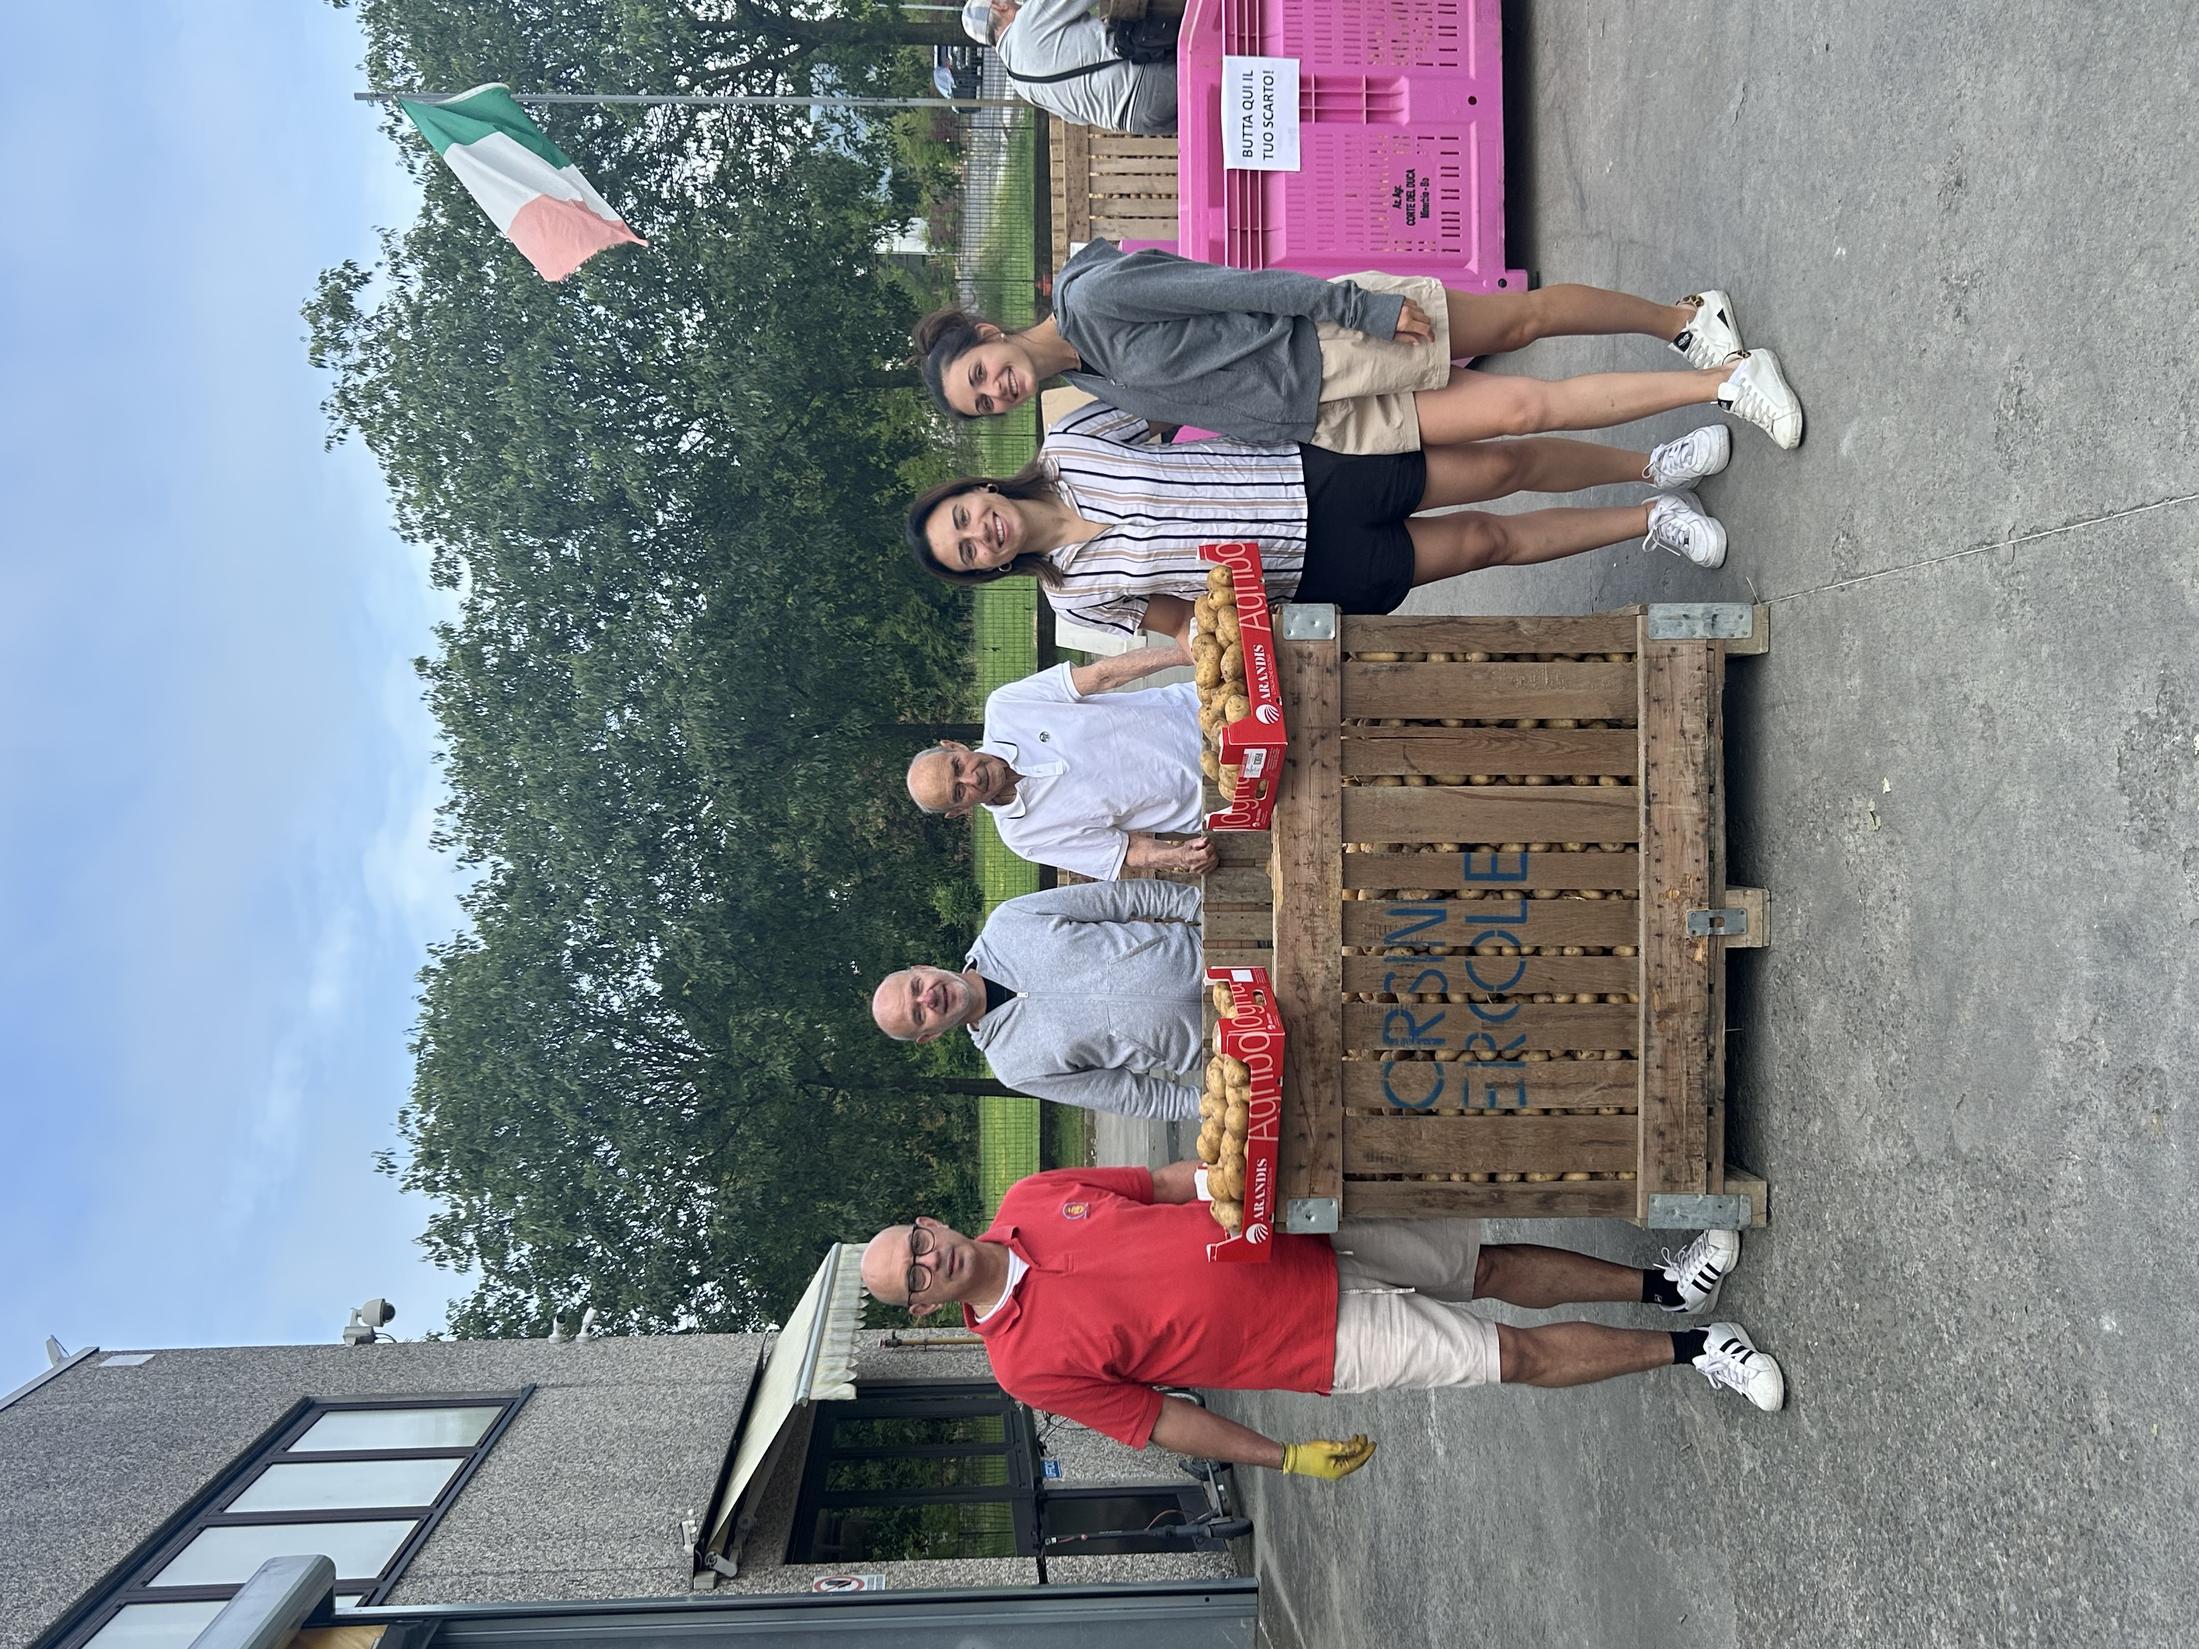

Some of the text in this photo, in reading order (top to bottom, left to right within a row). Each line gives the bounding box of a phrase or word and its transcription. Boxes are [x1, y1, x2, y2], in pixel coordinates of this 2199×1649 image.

[1242, 70, 1255, 158] BUTTA QUI IL
[1262, 70, 1274, 160] TUO SCARTO!
[1406, 169, 1415, 226] CORTE DEL DUCA
[1253, 644, 1271, 702] ARANDIS
[1463, 853, 1529, 1109] ERCOLE
[1253, 1158, 1267, 1221] ARANDIS
